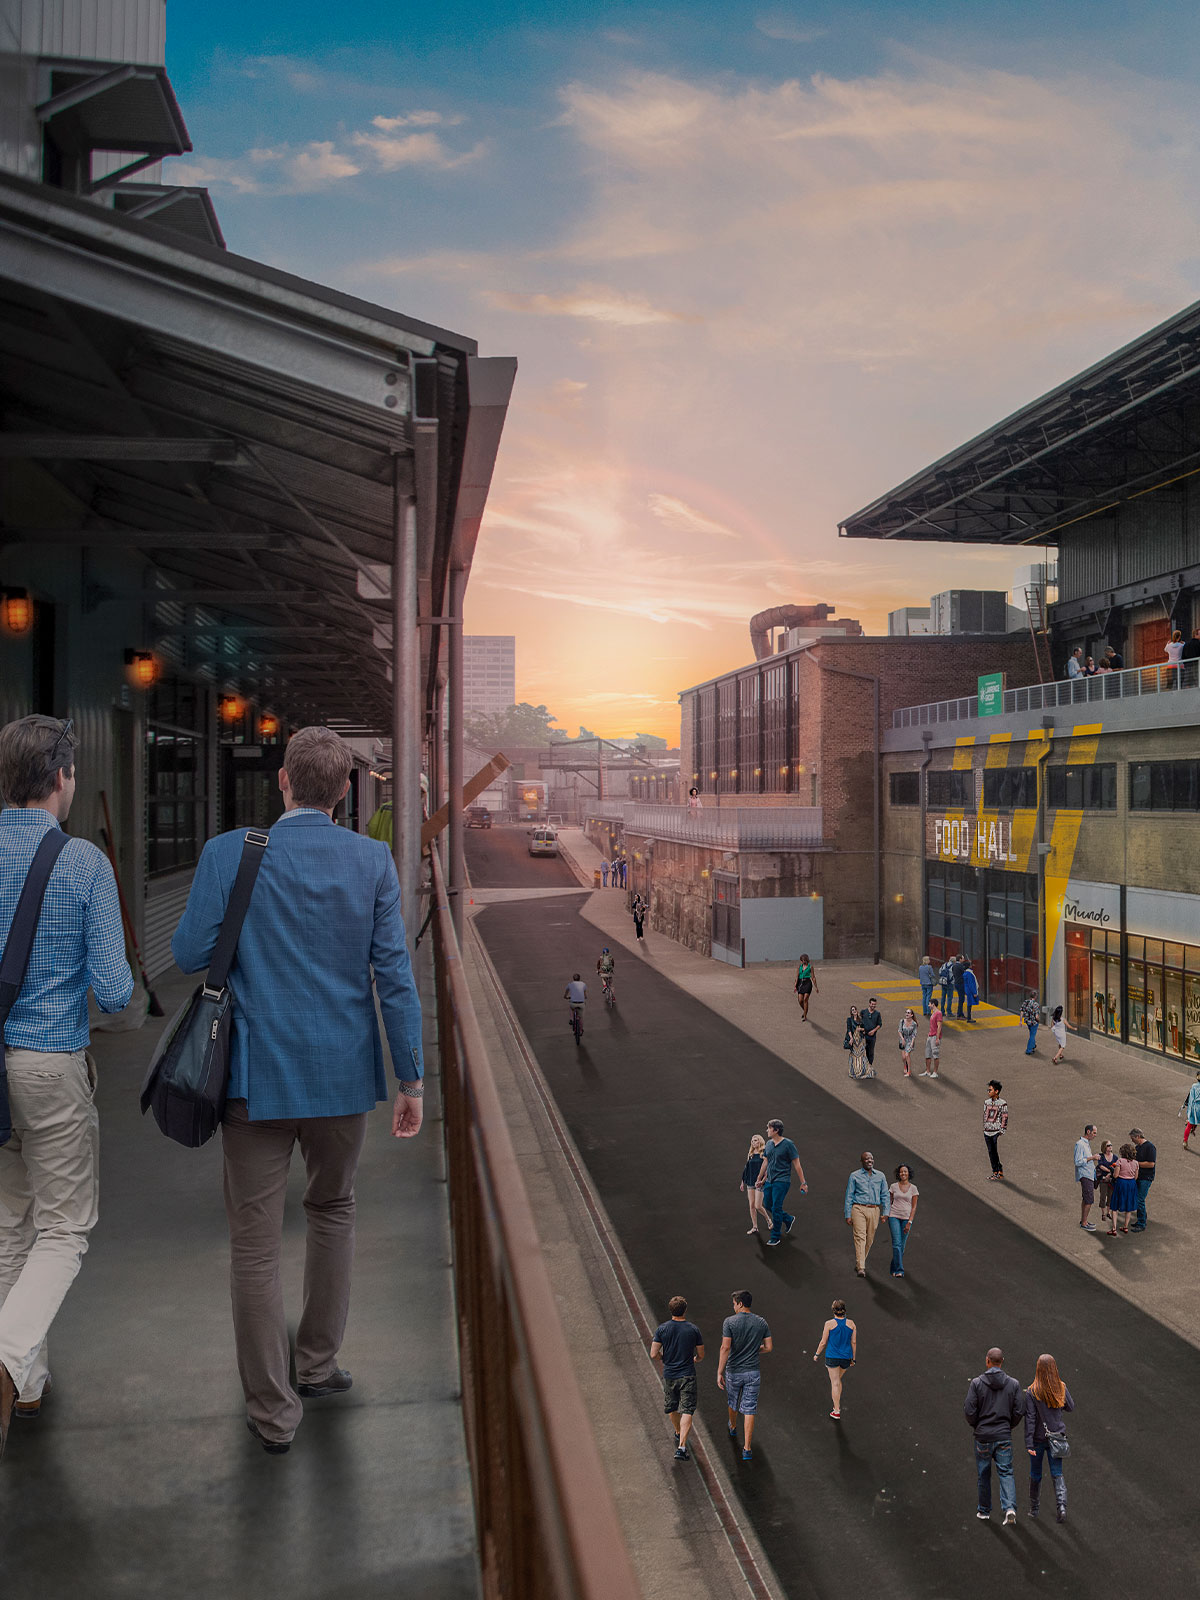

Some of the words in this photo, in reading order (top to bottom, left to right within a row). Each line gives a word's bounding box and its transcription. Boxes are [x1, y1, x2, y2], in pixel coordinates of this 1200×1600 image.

[935, 819, 969, 857] FOOD
[977, 820, 1018, 862] HALL
[1064, 903, 1110, 927] Mundo
